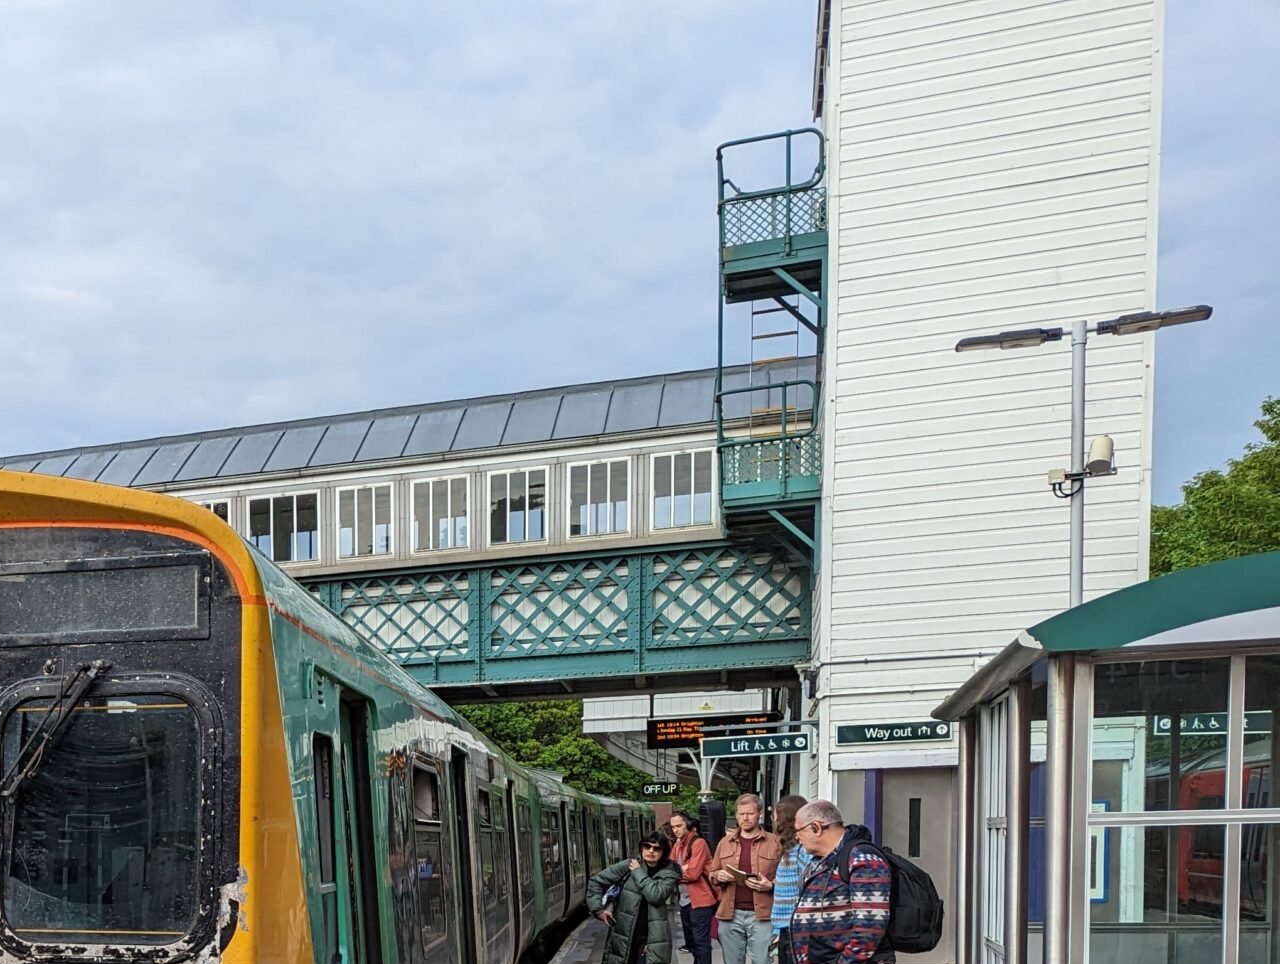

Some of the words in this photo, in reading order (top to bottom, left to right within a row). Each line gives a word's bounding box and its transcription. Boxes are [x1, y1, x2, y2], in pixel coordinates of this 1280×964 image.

[865, 727, 891, 740] Way
[893, 727, 912, 737] out
[731, 740, 750, 752] Lift
[643, 784, 661, 794] OFF
[662, 784, 677, 793] UP
